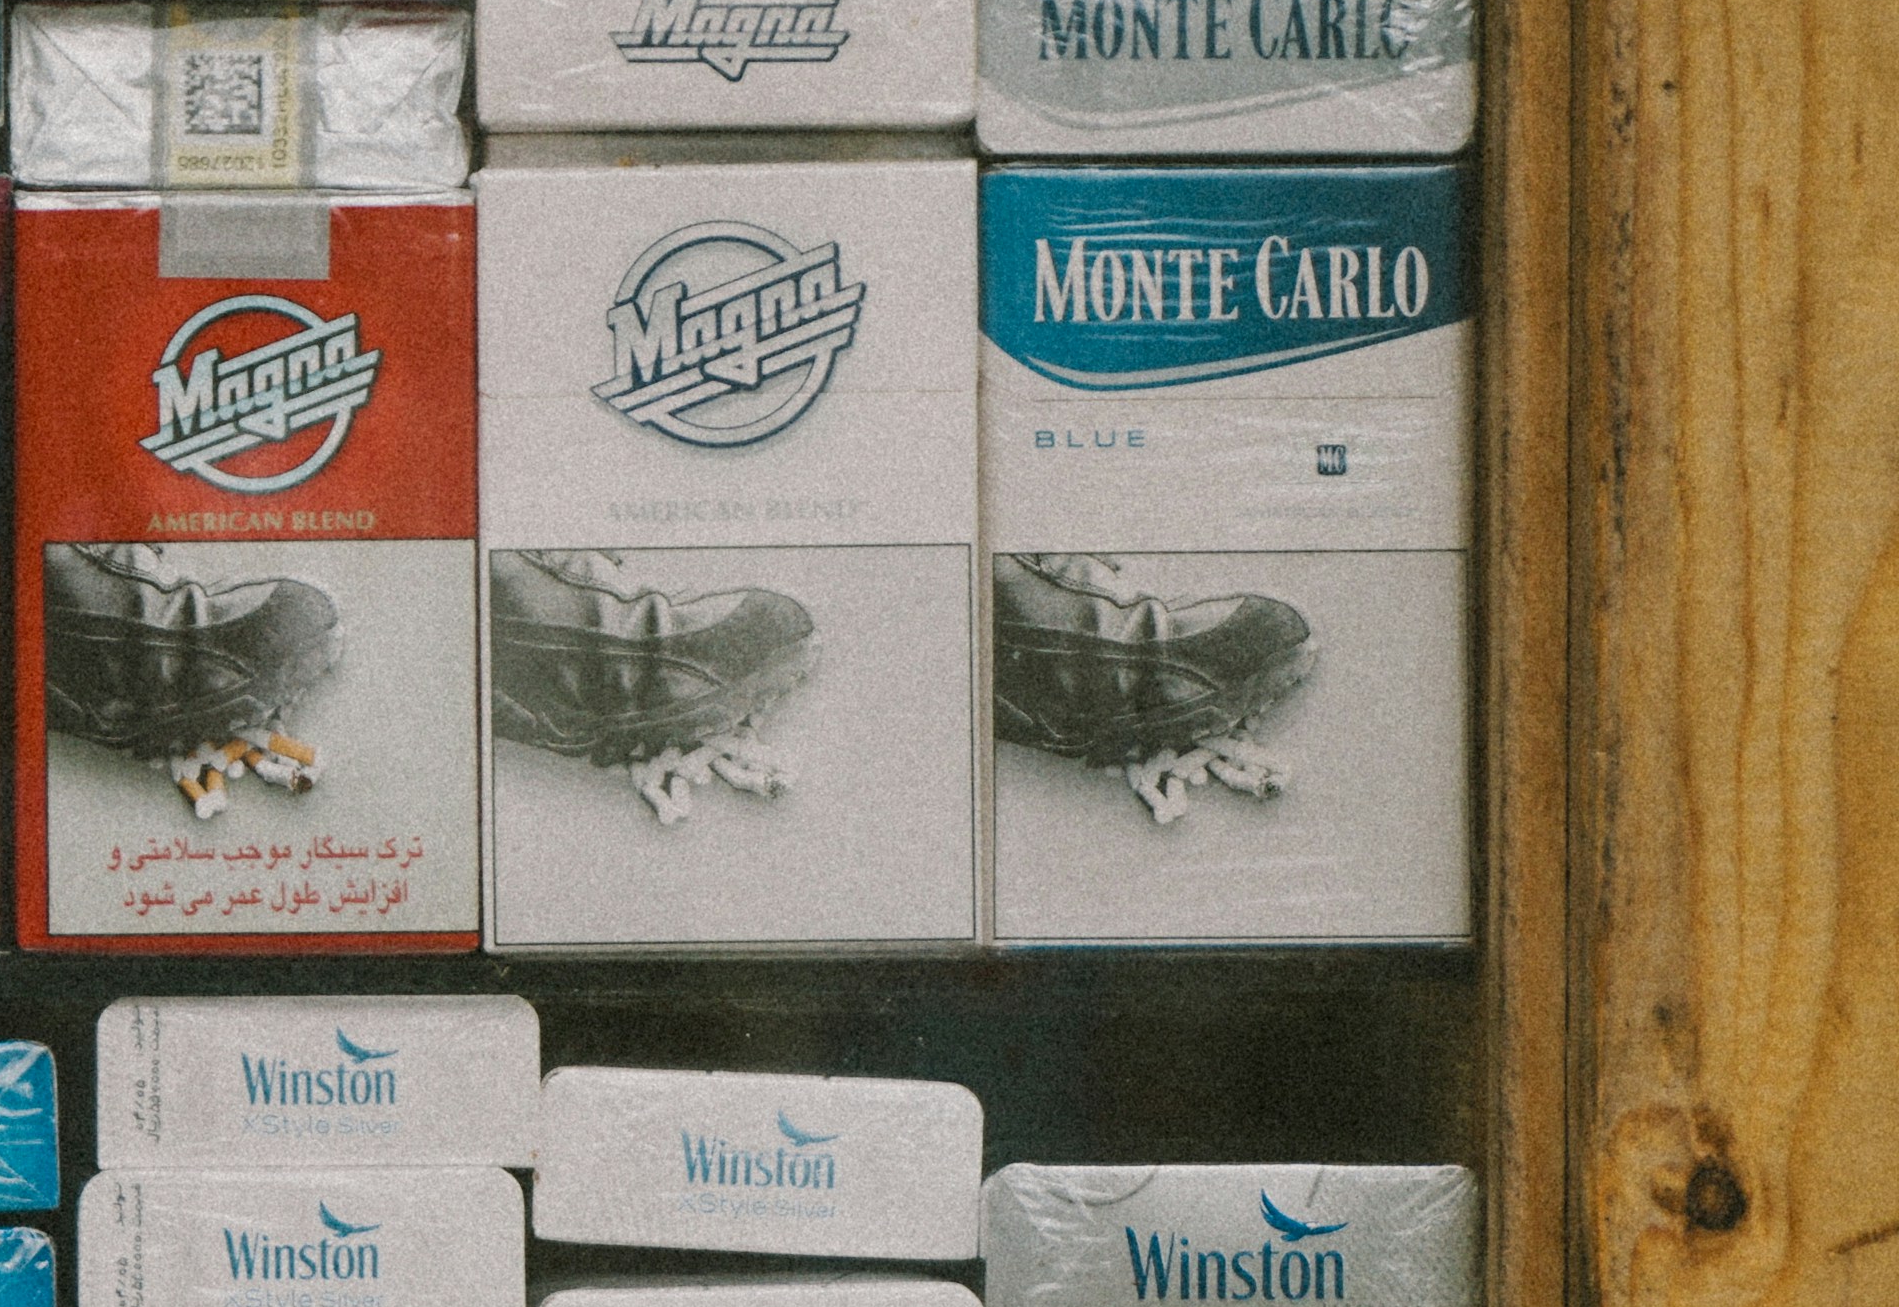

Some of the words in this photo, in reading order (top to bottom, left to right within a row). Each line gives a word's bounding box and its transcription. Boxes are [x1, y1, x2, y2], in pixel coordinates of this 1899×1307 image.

[1035, 239, 1240, 321] MONTE
[1255, 235, 1428, 320] CARLO
[598, 255, 846, 393] Magna
[147, 315, 370, 450] Magna
[1036, 431, 1145, 447] BLUE
[147, 513, 284, 532] AMERICAN
[292, 510, 375, 531] BLEND
[242, 1053, 396, 1107] Winston
[681, 1130, 834, 1190] Winston
[225, 1227, 379, 1281] Winston
[1126, 1228, 1344, 1303] Winston
